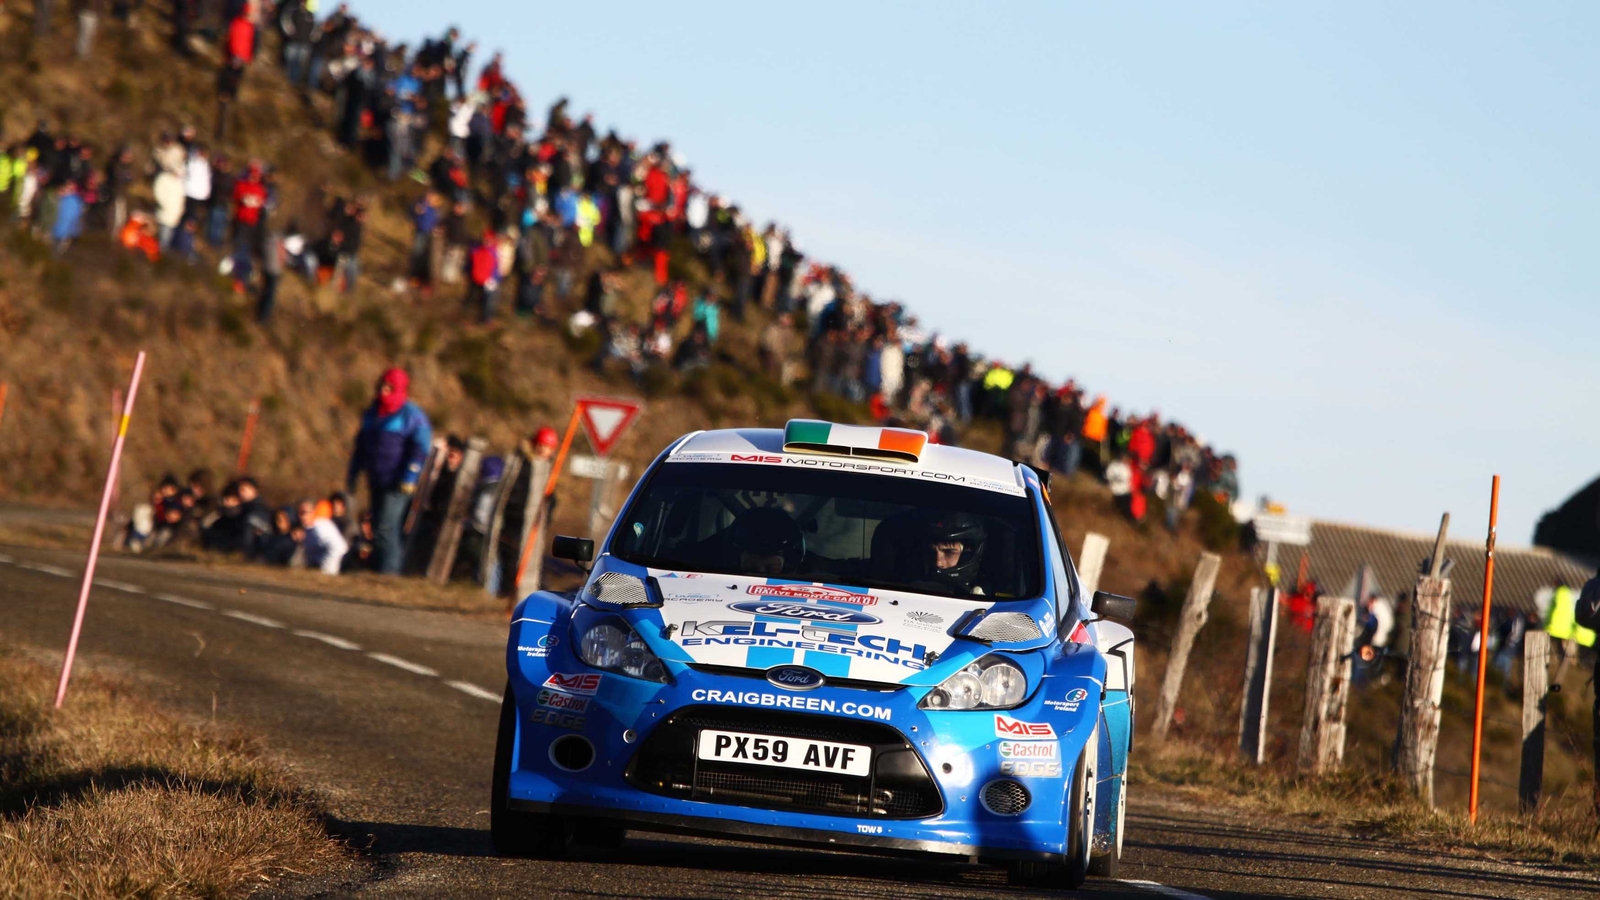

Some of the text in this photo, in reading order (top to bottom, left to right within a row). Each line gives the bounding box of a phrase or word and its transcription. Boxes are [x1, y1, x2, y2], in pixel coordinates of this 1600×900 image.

[731, 454, 965, 483] MIS MOTORSPORT.COM
[756, 602, 854, 621] Ford
[680, 620, 927, 661] KEL-TECH
[682, 637, 925, 671] ENGINEERING
[547, 673, 601, 690] MIS
[778, 669, 810, 685] Ford
[548, 693, 587, 712] Castrol
[691, 689, 892, 721] CRAIGBREEN.COM
[1044, 700, 1080, 708] Motorsport
[530, 708, 587, 731] EDGE
[996, 716, 1052, 735] MIS
[714, 734, 856, 770] PX59 AVF
[1012, 743, 1053, 757] Castrol
[1000, 761, 1060, 776] EDGE
